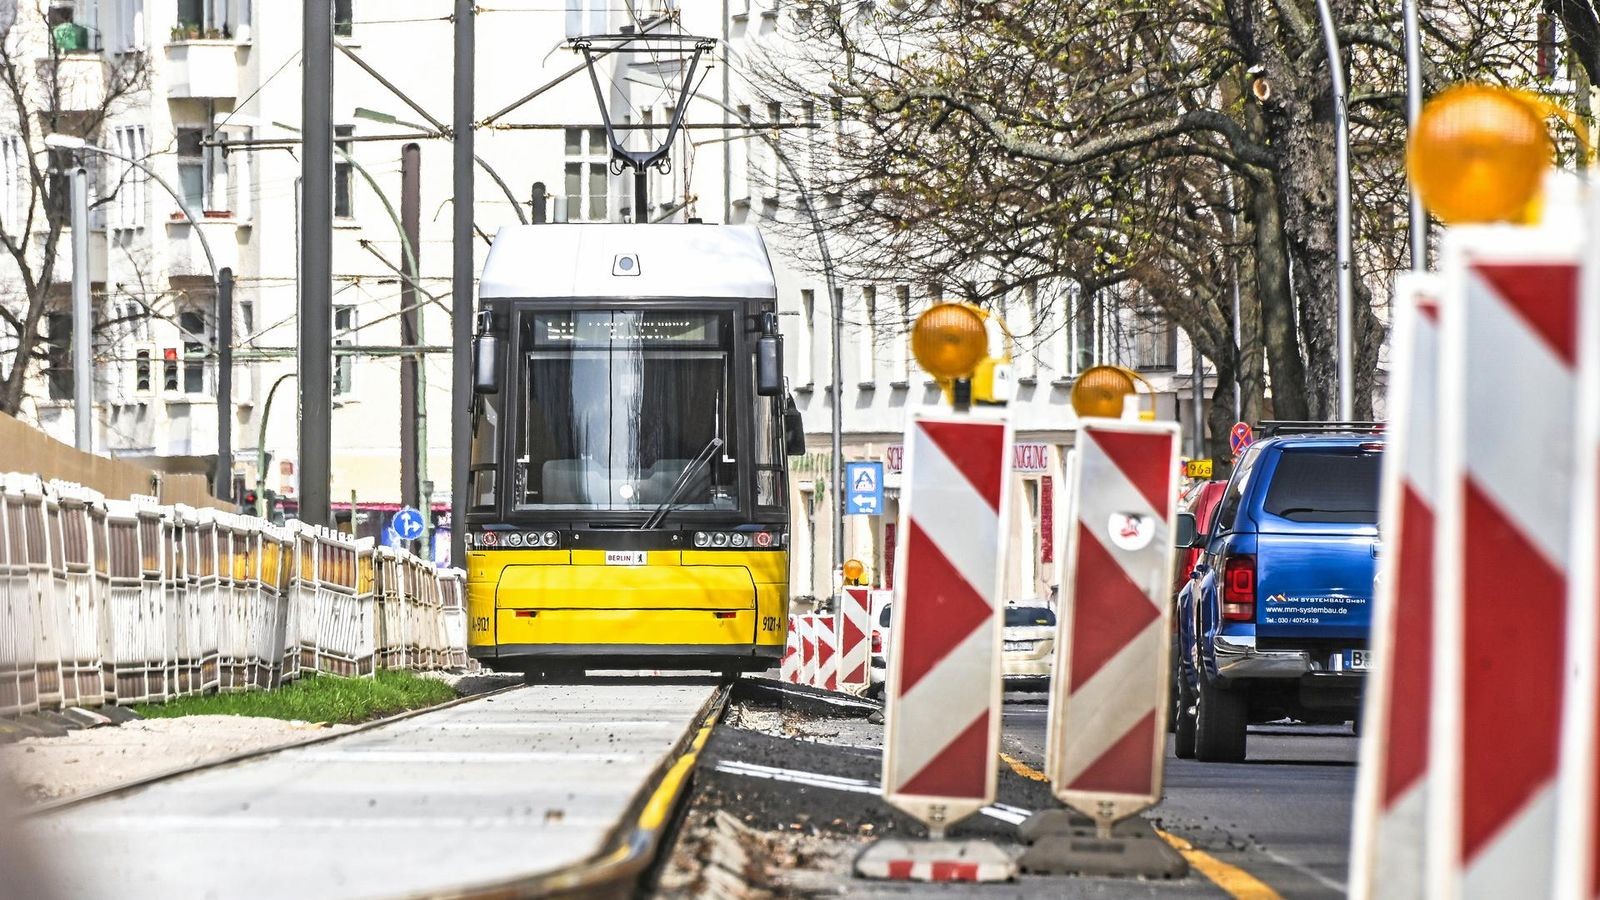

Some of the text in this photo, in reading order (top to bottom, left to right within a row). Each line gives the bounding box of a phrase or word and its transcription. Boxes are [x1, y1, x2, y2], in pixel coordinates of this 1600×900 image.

[1190, 464, 1211, 474] 96a
[607, 554, 631, 562] BERLIN
[1265, 606, 1348, 615] www.mm-systembau.de
[762, 616, 782, 631] 9121-A
